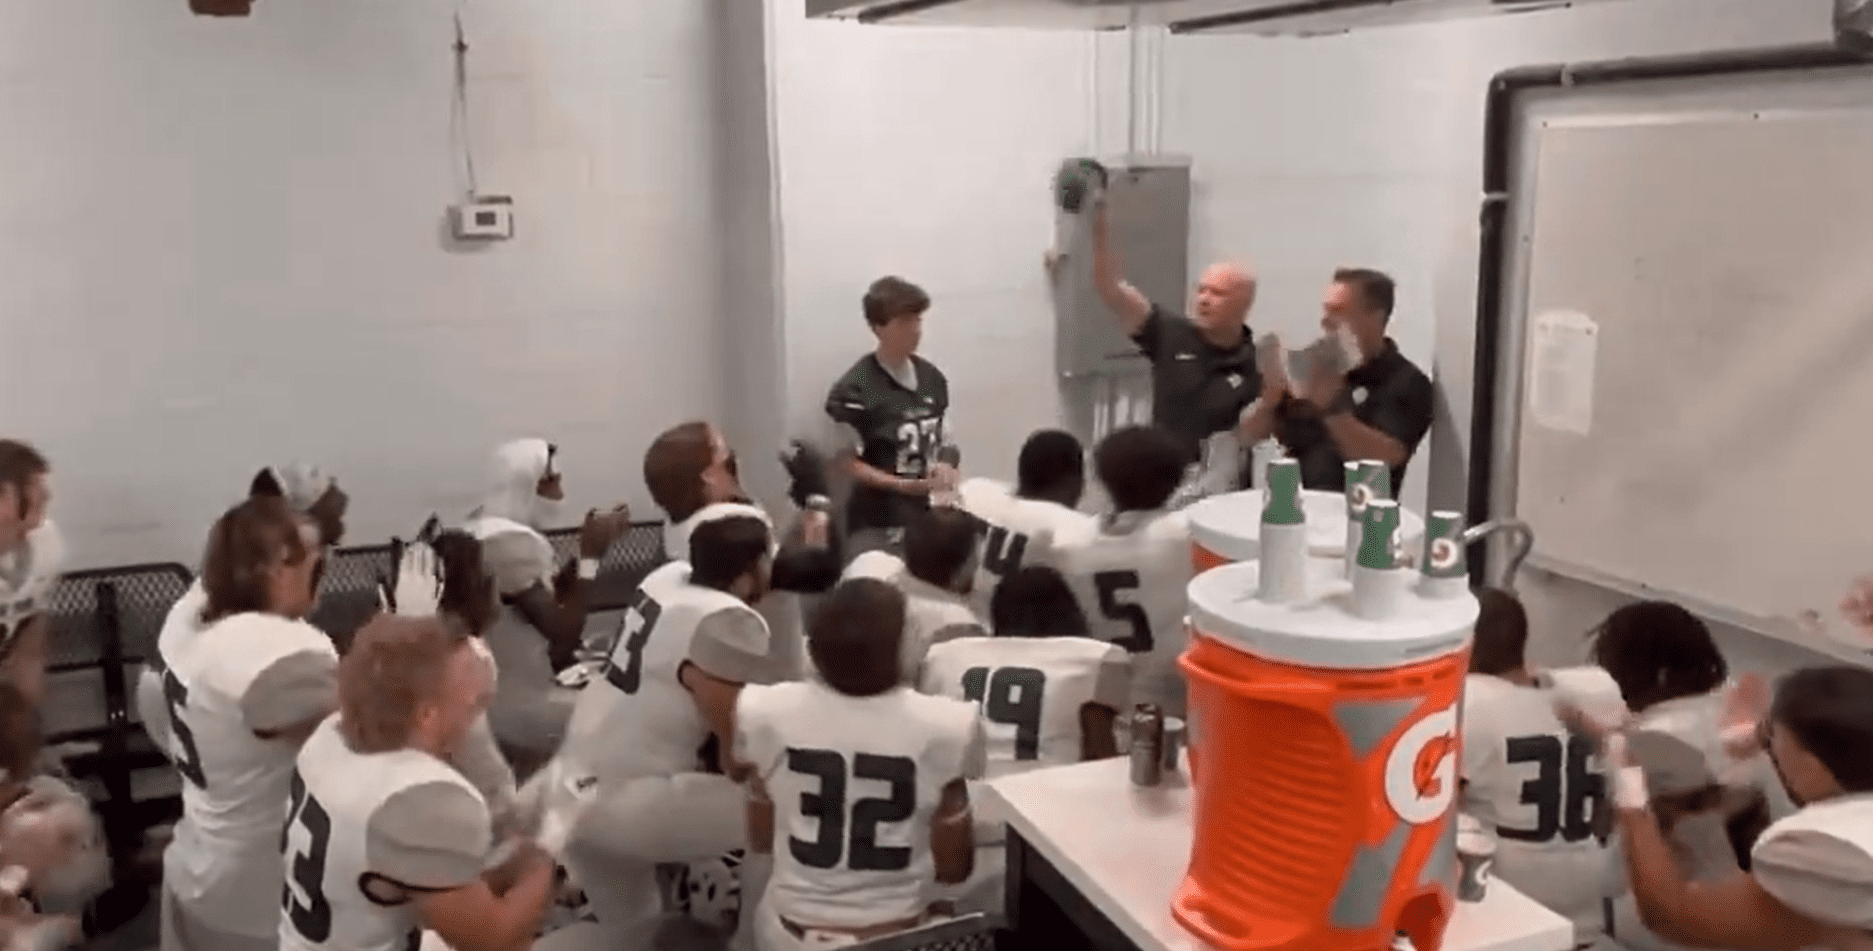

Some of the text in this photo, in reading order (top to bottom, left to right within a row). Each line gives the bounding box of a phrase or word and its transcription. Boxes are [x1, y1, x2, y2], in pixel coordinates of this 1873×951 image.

[606, 594, 662, 695] 3
[1094, 569, 1155, 653] 5
[784, 746, 917, 871] 32
[1385, 704, 1457, 824] G
